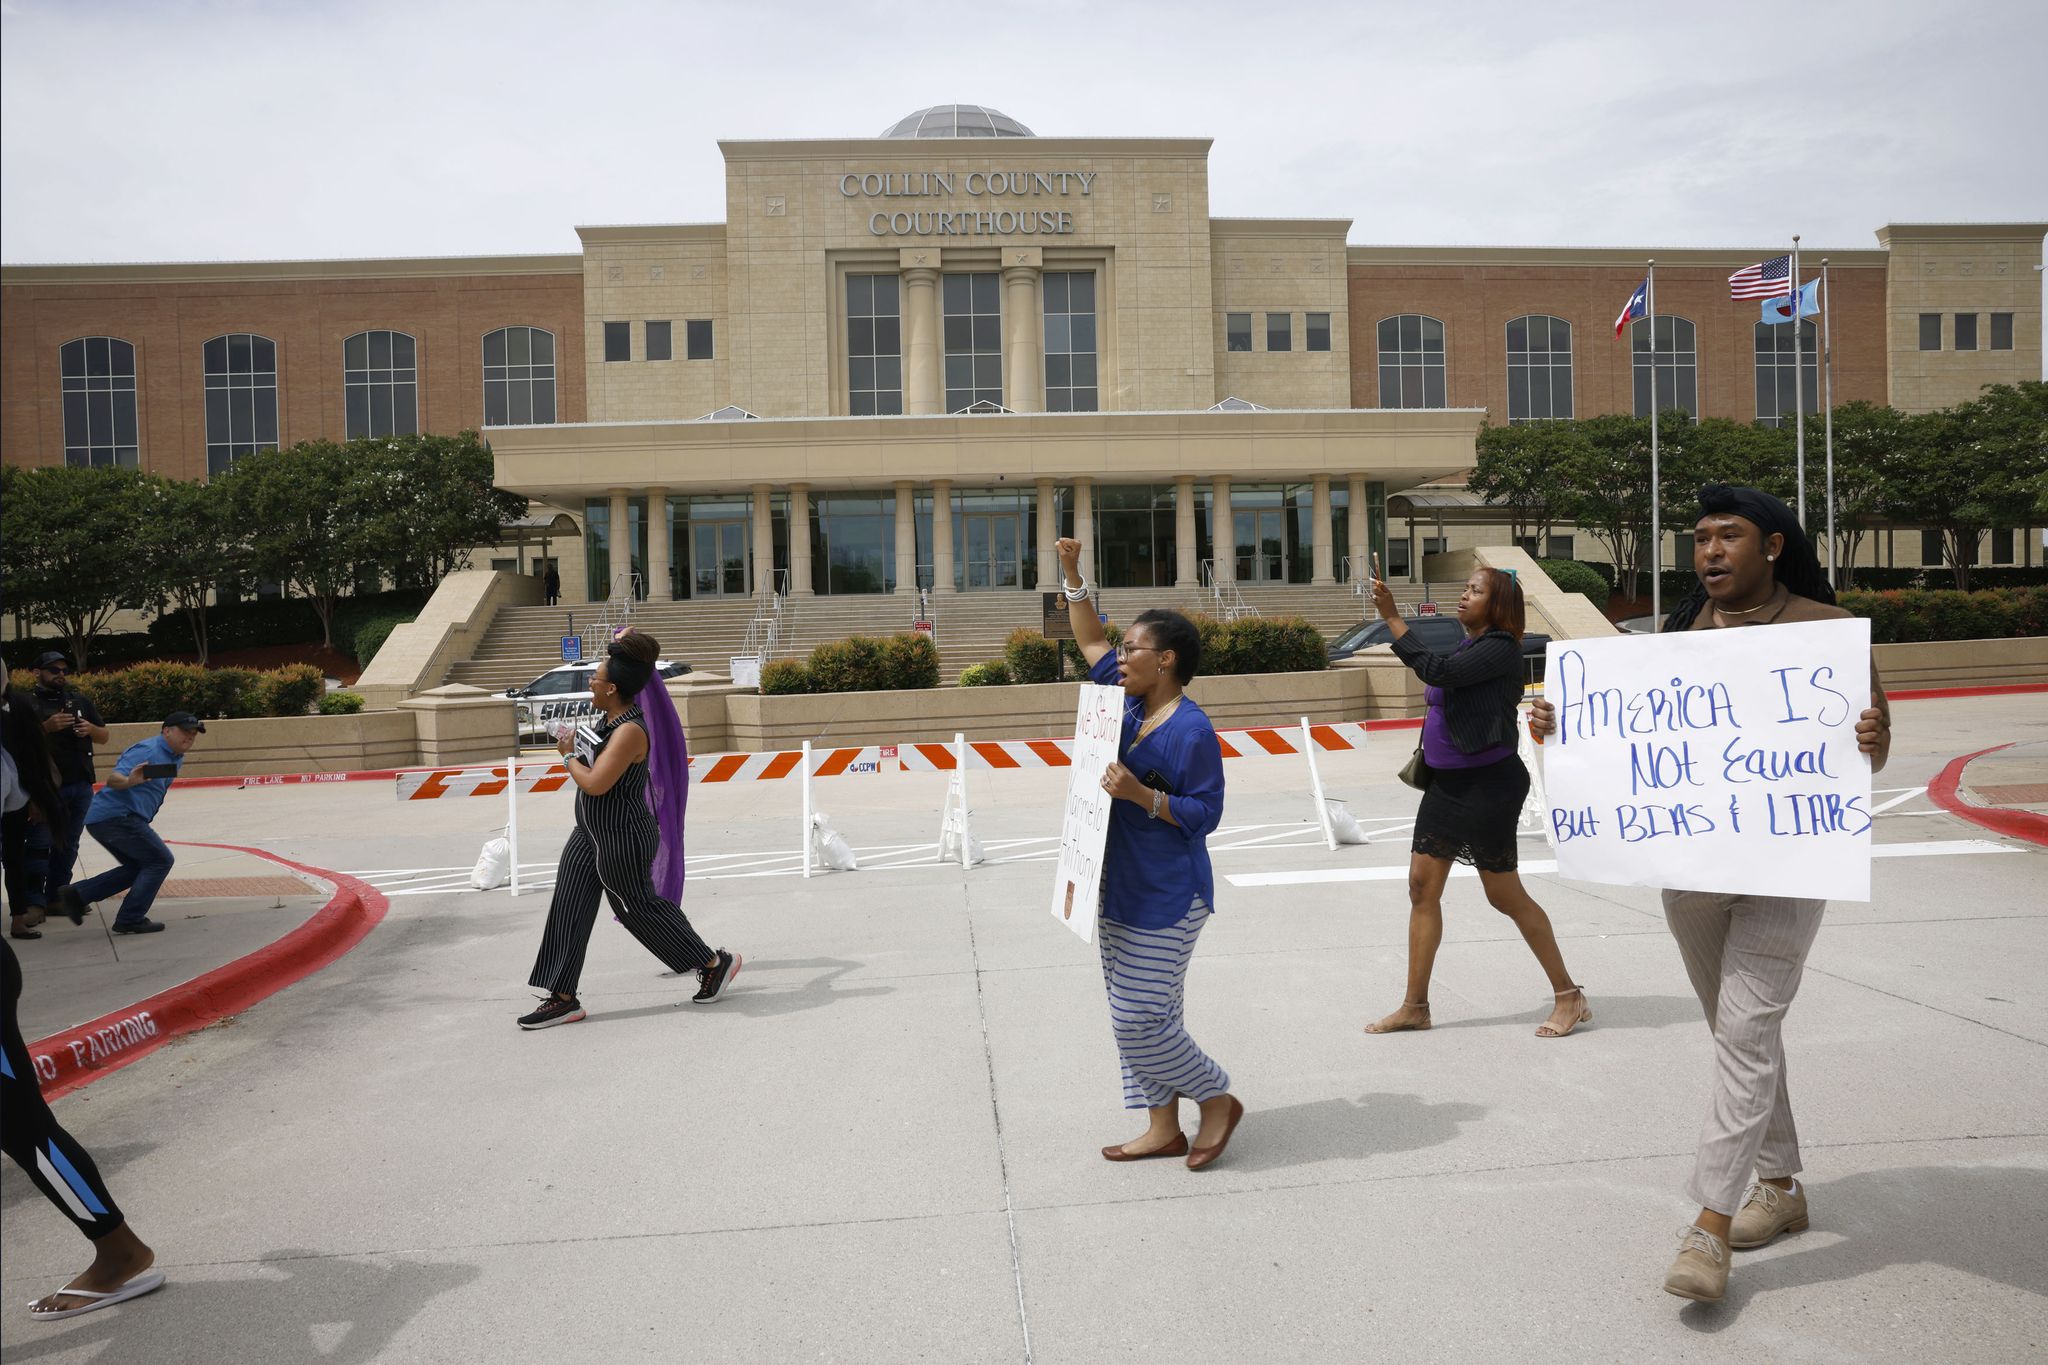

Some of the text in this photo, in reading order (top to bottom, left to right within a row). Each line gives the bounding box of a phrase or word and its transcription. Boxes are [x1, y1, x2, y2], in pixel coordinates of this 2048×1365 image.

[840, 172, 1097, 197] COLLIN COUNTY
[868, 211, 1075, 236] COURTHOUSE
[1769, 666, 1850, 727] IS
[243, 773, 346, 785] FIRE LANE NO PARKING
[858, 762, 875, 772] CCPW
[1616, 803, 1716, 842] BIAS
[1767, 793, 1872, 837] LIARS
[67, 1011, 158, 1068] PARKING
